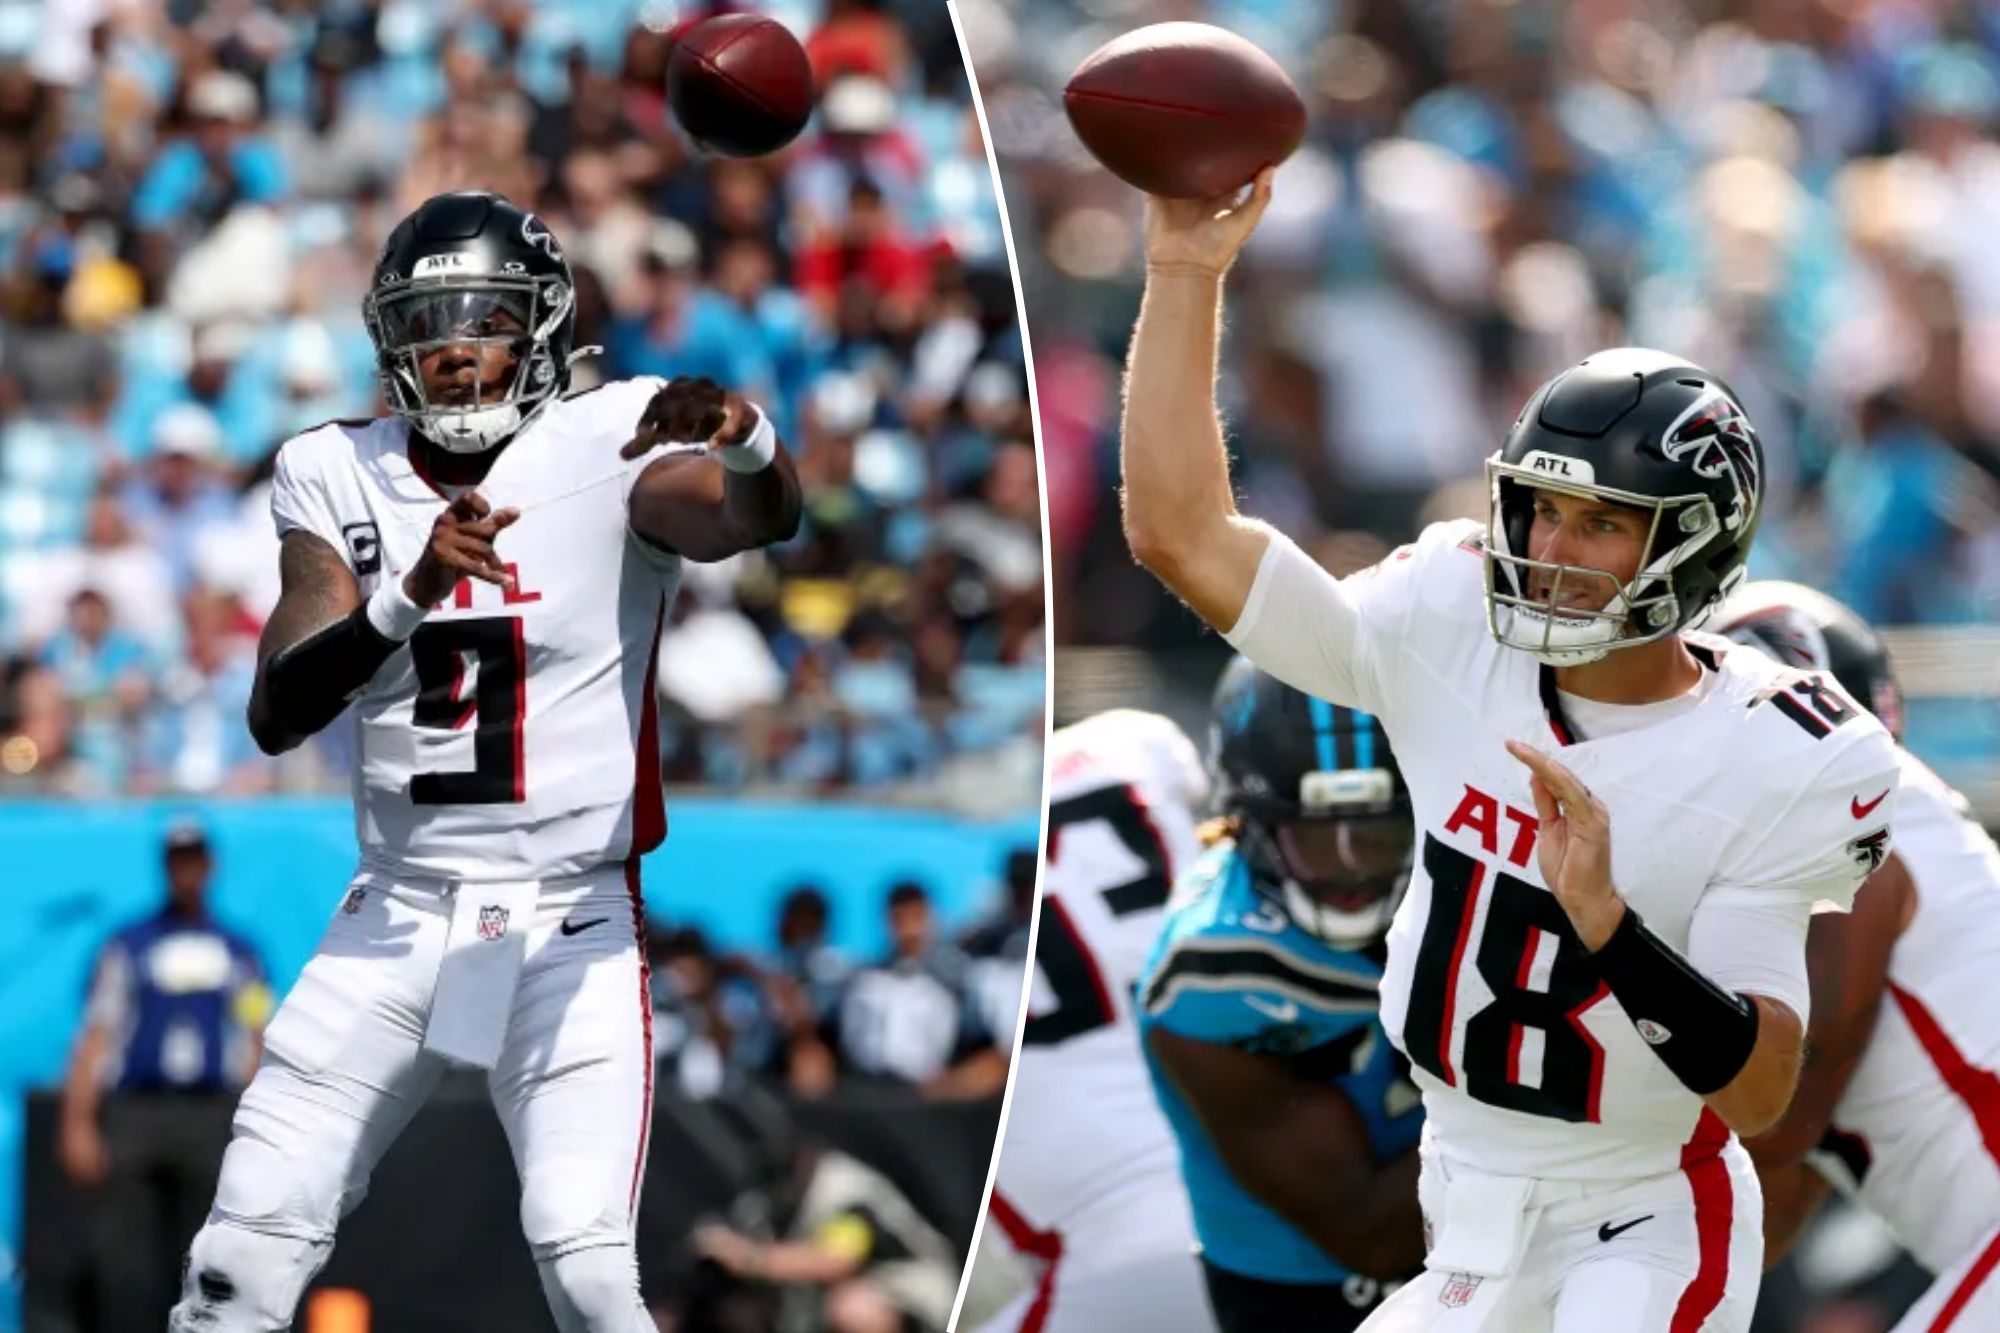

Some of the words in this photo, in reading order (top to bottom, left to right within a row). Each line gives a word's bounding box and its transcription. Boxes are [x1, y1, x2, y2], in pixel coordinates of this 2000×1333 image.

[1533, 456, 1572, 476] ATL
[409, 616, 526, 805] 9
[1444, 783, 1541, 868] AT
[1402, 829, 1606, 1124] 18
